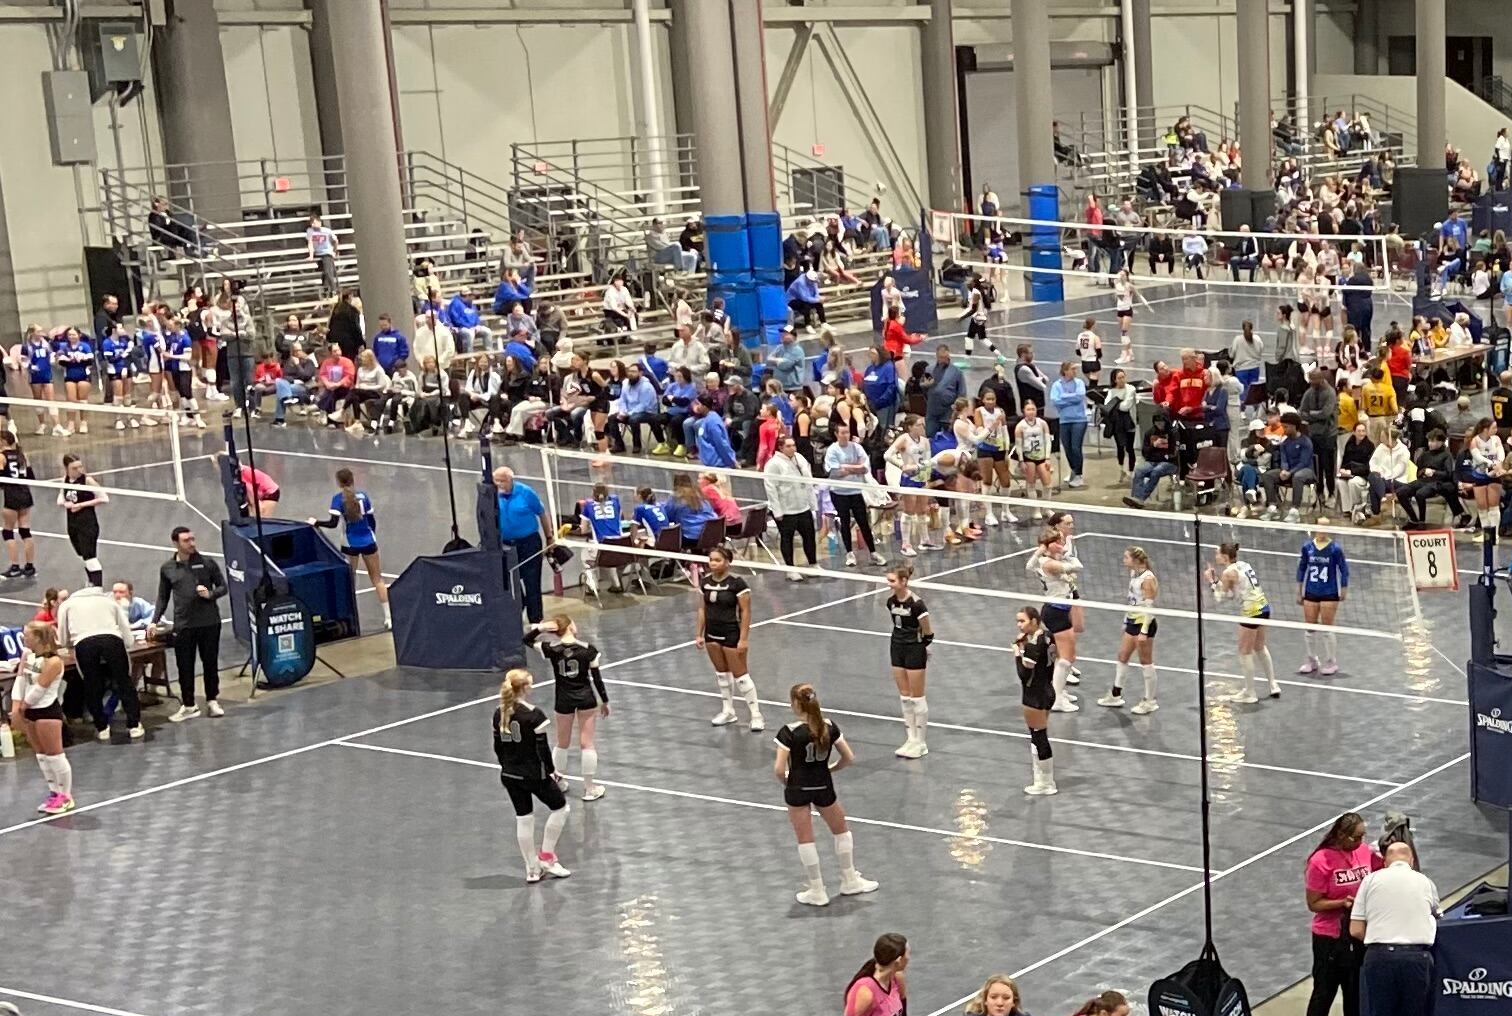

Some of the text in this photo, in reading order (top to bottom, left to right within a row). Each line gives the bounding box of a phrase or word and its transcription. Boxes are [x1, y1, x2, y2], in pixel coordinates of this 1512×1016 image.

[652, 507, 666, 522] 5
[1413, 537, 1447, 548] COURT
[1427, 550, 1438, 578] 8
[1309, 565, 1329, 583] 24
[435, 592, 483, 605] SPALDING
[268, 612, 303, 625] WATCH
[274, 621, 305, 634] SHARE
